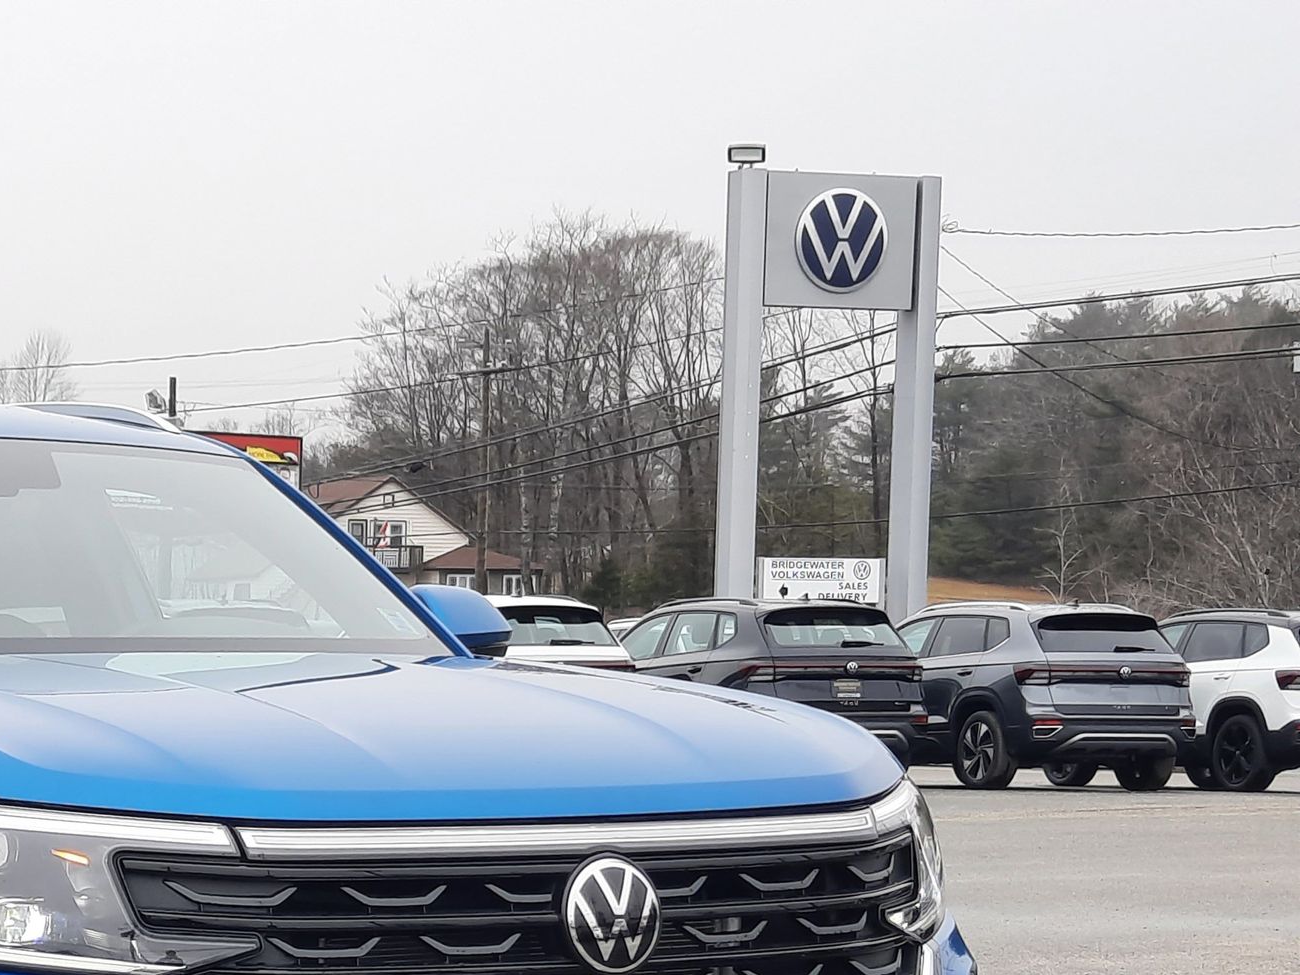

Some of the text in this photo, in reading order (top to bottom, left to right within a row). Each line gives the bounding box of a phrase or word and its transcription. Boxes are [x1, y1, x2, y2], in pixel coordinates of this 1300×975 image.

[771, 560, 845, 570] BRIDGEWATER
[771, 571, 845, 579] VOLKSWAGEN
[838, 582, 868, 590] SALES
